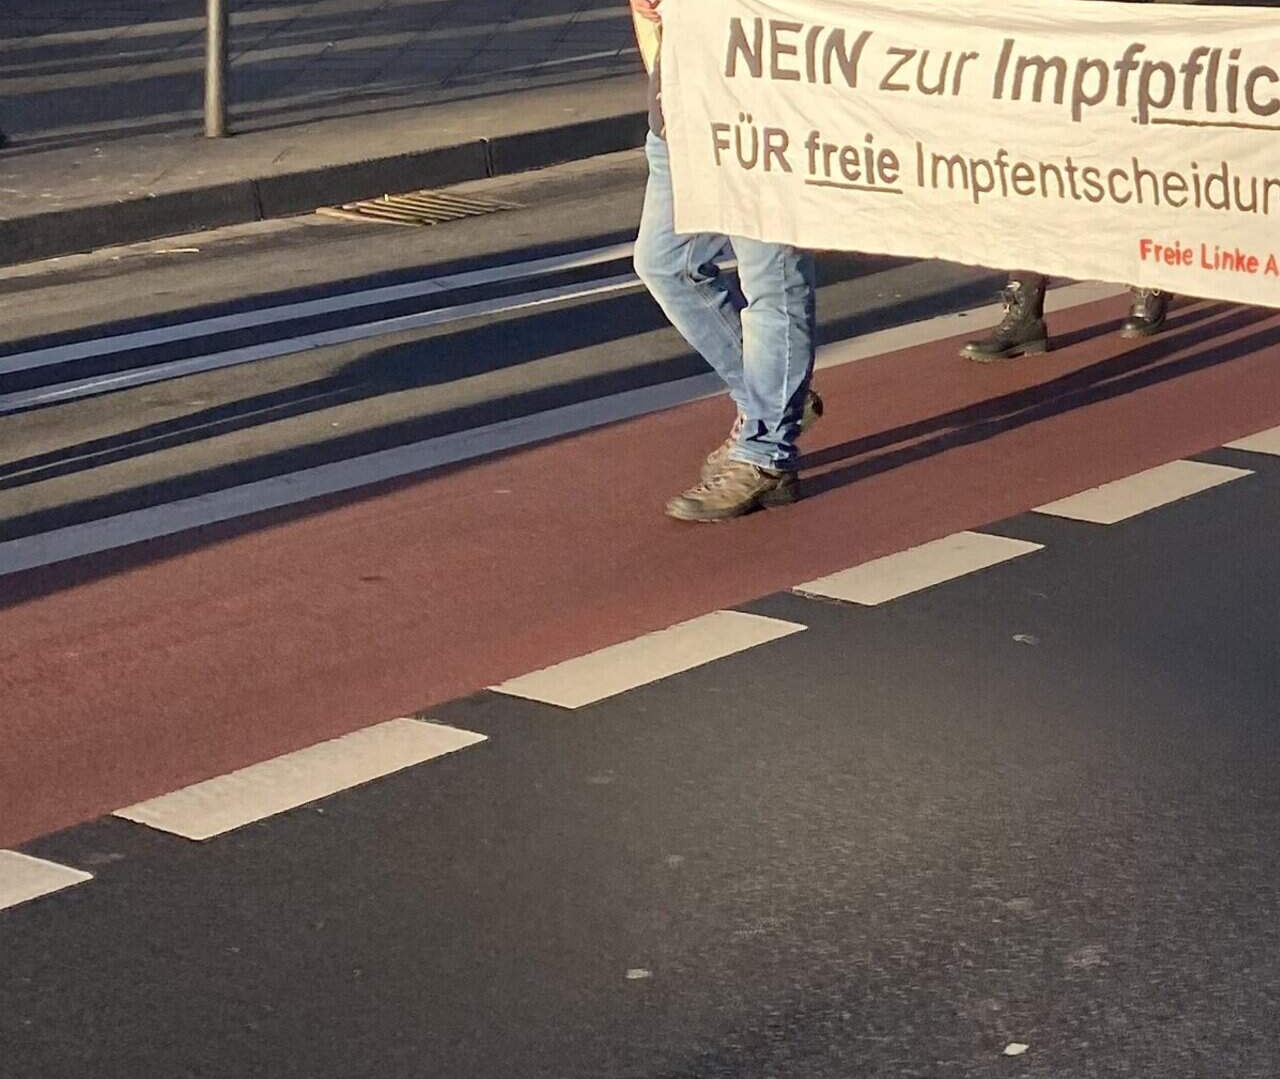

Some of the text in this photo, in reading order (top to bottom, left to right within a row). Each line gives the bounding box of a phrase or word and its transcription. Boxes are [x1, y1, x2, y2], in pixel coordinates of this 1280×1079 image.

[725, 16, 874, 89] NEIN
[878, 46, 980, 97] zur
[710, 111, 793, 173] FÜR
[804, 130, 900, 185] freie
[1139, 238, 1194, 266] Freie
[1200, 242, 1260, 275] Linke
